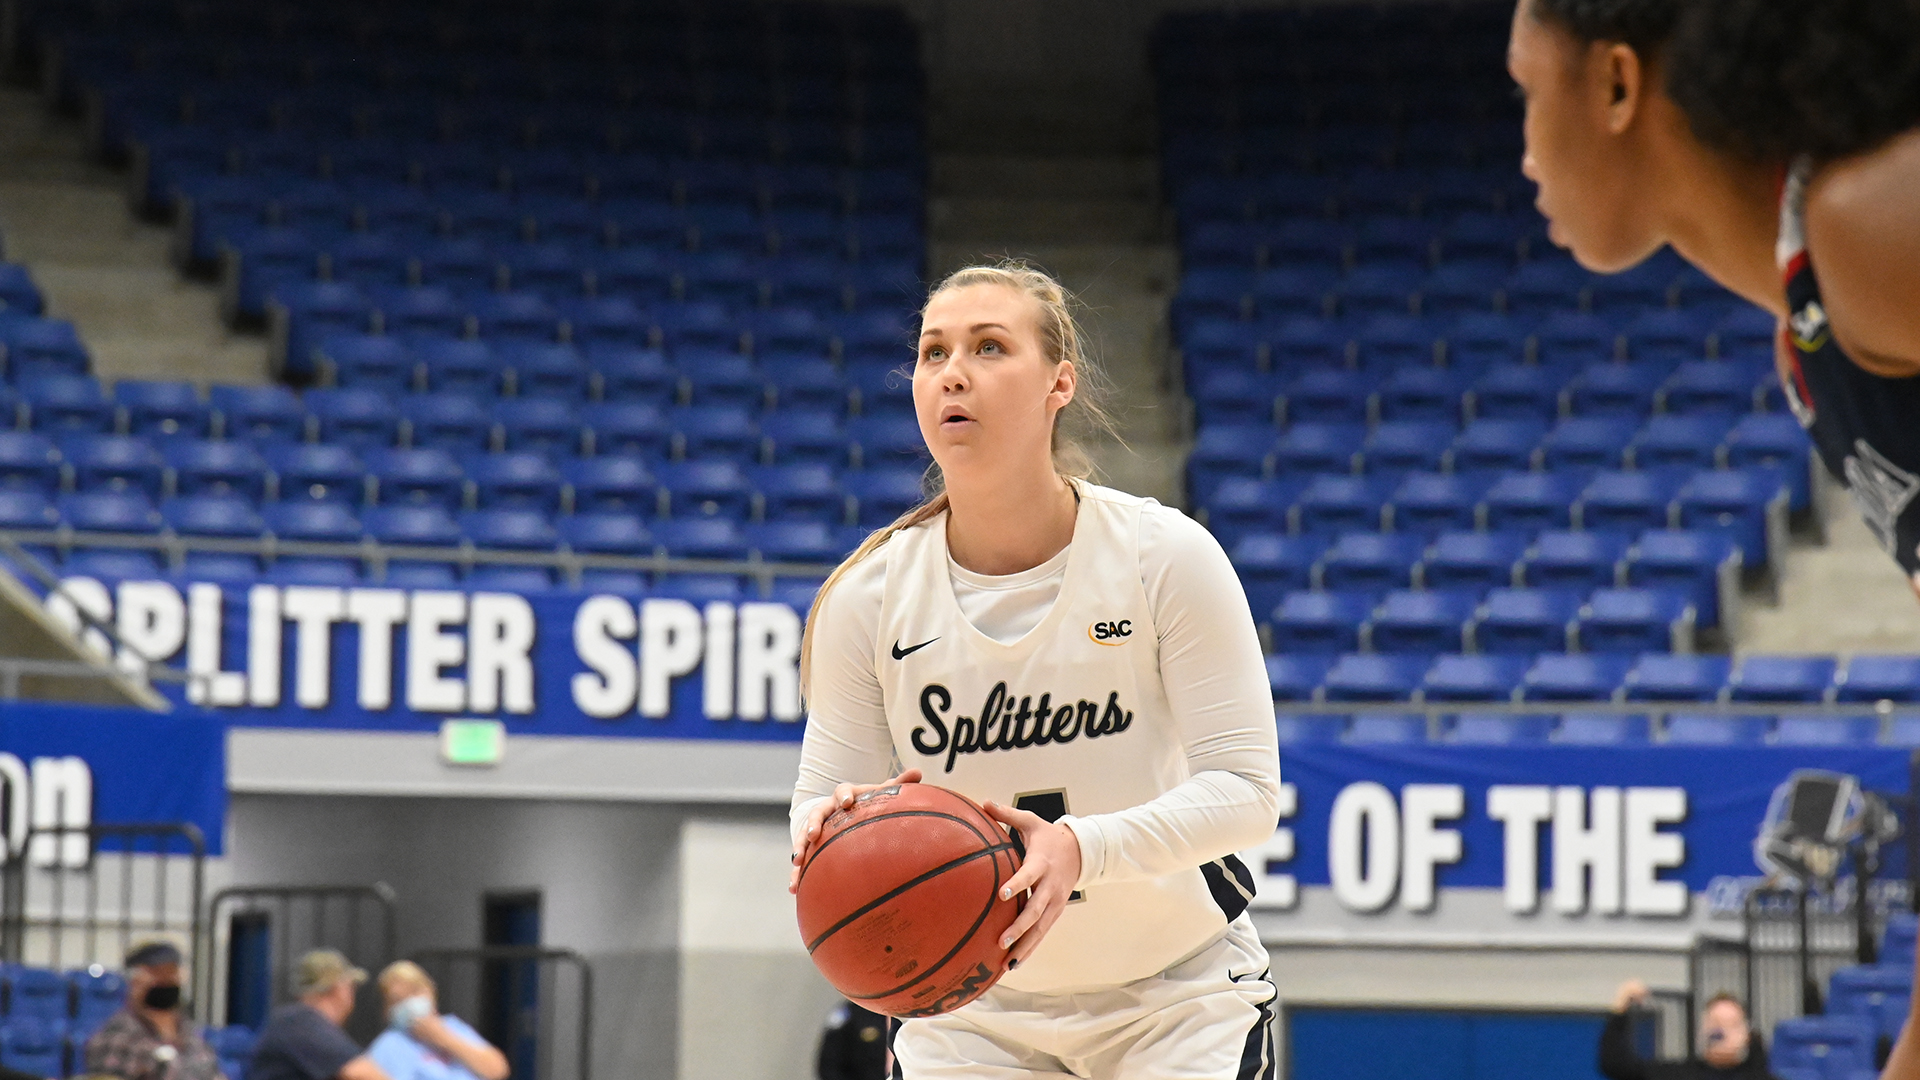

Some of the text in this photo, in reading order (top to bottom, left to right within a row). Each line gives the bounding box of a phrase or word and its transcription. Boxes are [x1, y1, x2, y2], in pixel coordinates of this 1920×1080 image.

[46, 575, 535, 715] SPLITTER
[1094, 619, 1133, 640] SAC
[910, 680, 1134, 774] Splitters
[1327, 781, 1464, 910] OF
[1487, 784, 1688, 916] THE
[893, 961, 994, 1018] NCA
